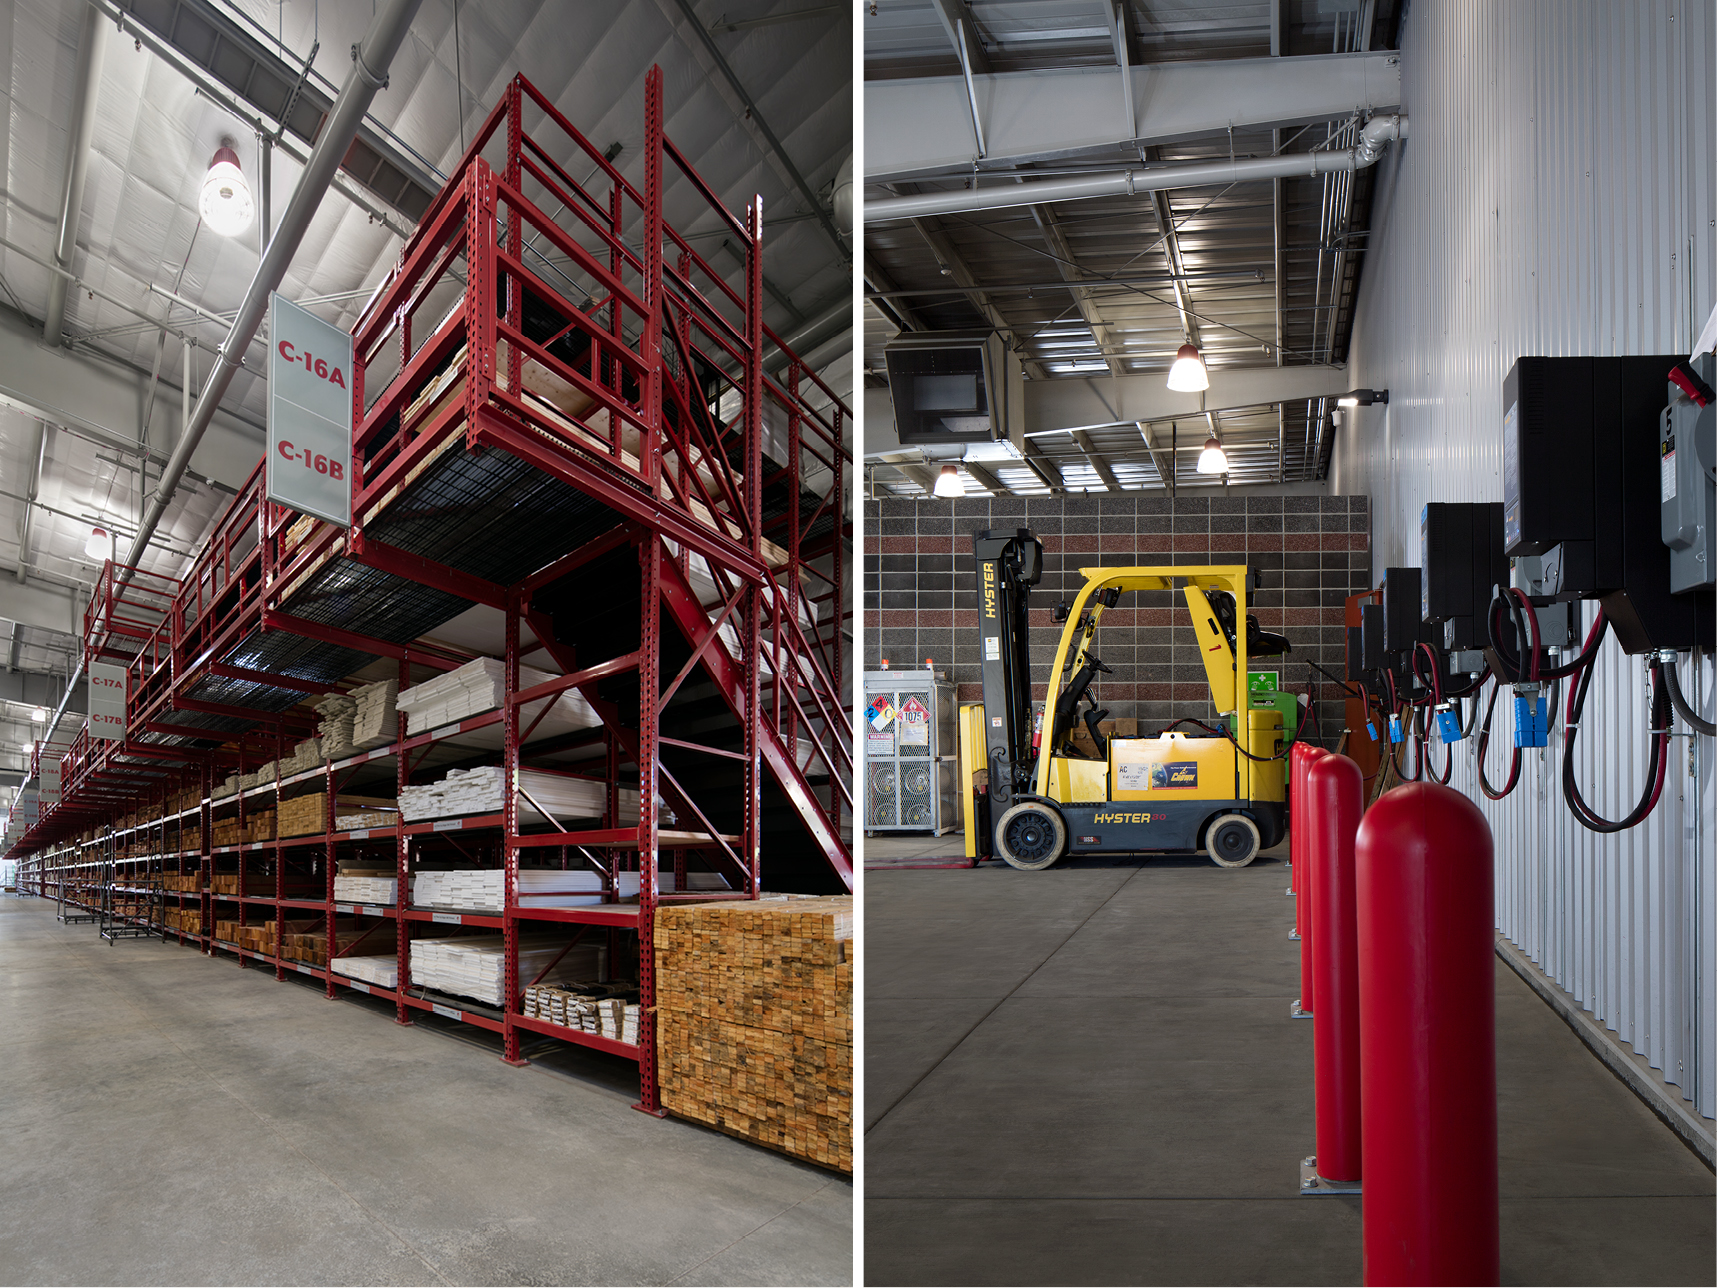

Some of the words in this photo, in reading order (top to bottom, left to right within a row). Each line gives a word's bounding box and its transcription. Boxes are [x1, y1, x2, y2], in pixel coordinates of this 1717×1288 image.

[278, 340, 346, 390] C-16A
[1666, 407, 1672, 435] 5
[277, 440, 344, 481] C-16B
[983, 562, 996, 619] HYSTER
[92, 677, 123, 689] C-17A
[875, 699, 884, 709] 4
[92, 713, 122, 725] C-17B
[867, 708, 875, 718] 2
[884, 708, 893, 719] 0
[904, 711, 922, 721] 1075
[1119, 765, 1128, 773] AC
[1094, 812, 1151, 824] HYSTER
[1151, 813, 1167, 821] 80
